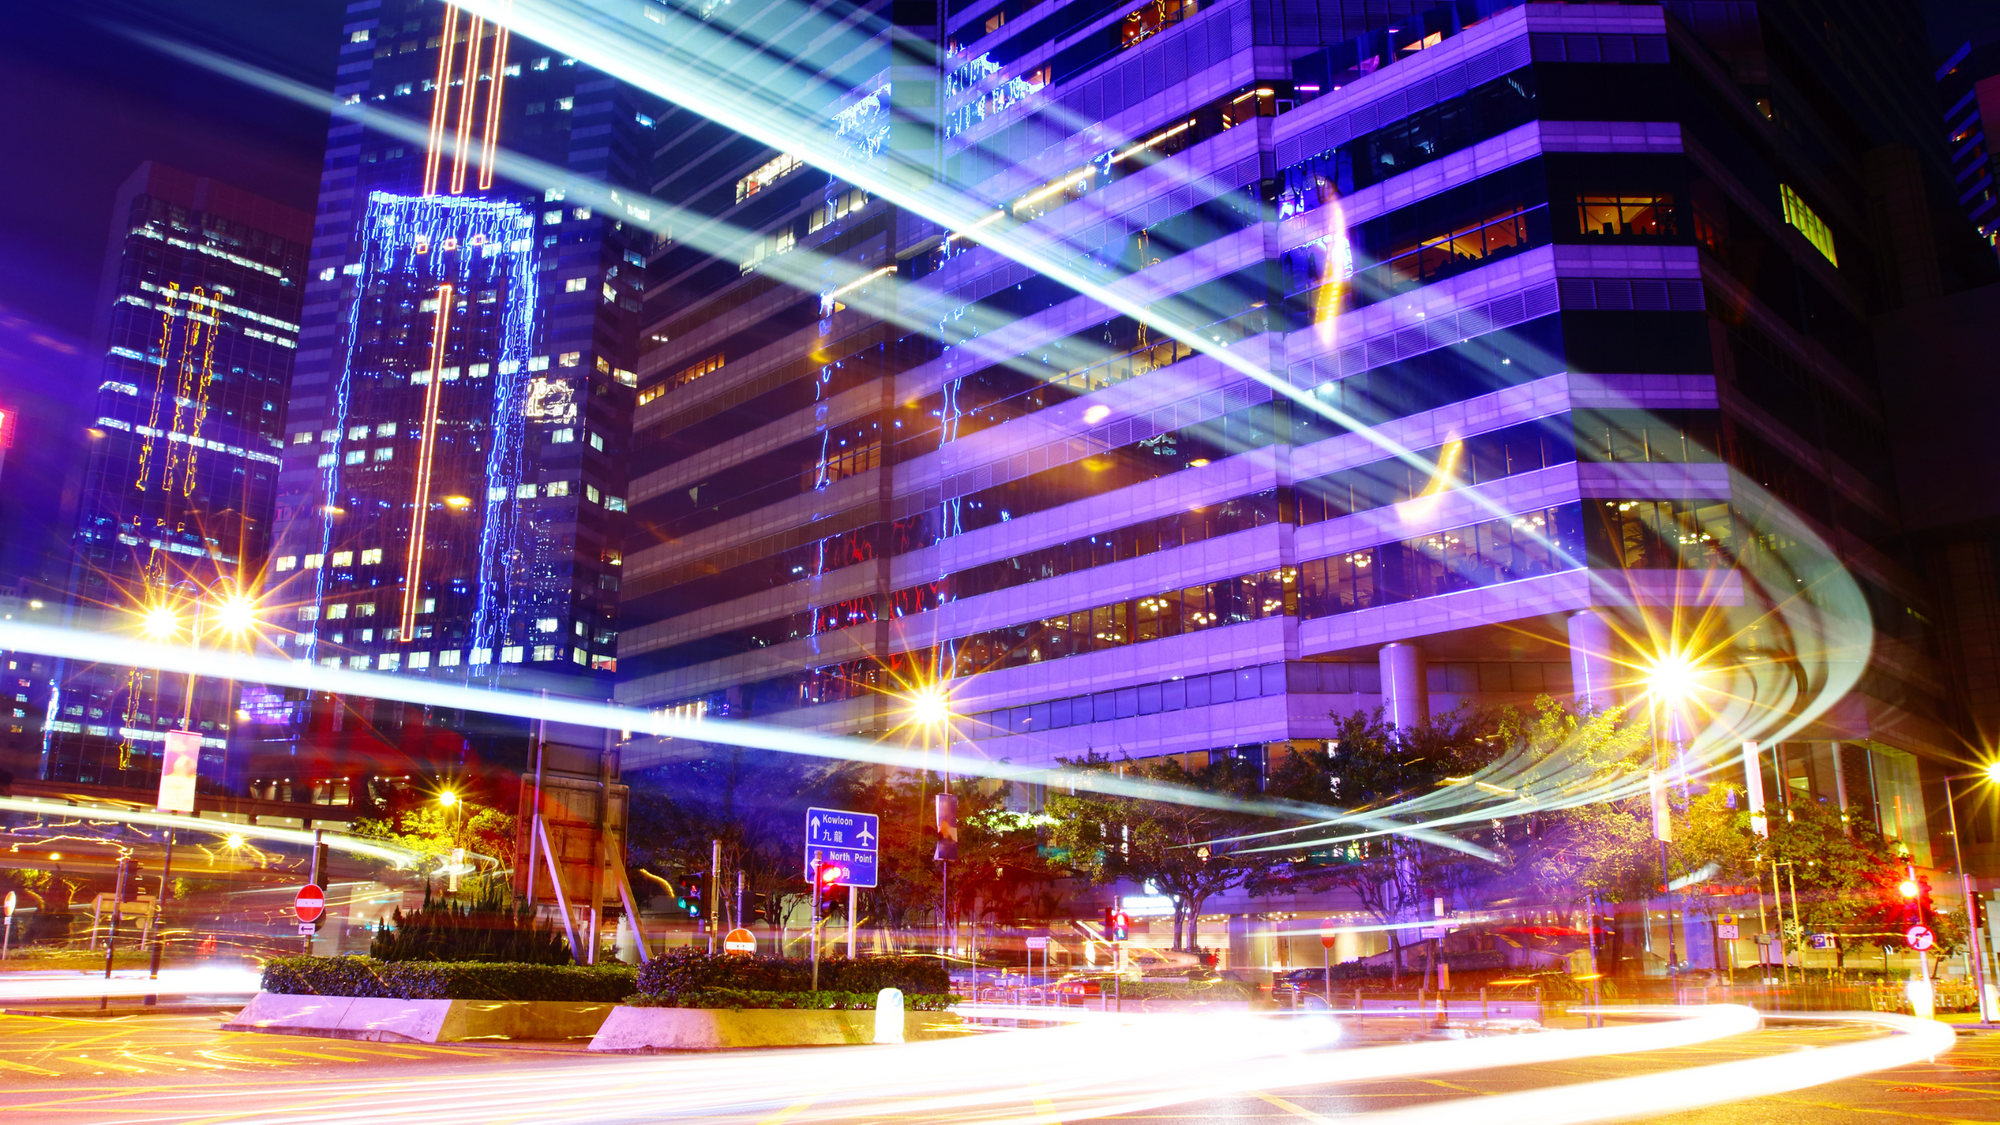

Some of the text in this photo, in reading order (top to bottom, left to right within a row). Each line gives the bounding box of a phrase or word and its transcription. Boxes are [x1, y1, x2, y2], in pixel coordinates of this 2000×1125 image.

[822, 814, 853, 826] Kowloon
[822, 829, 843, 843] 九龍
[830, 851, 872, 863] North Point
